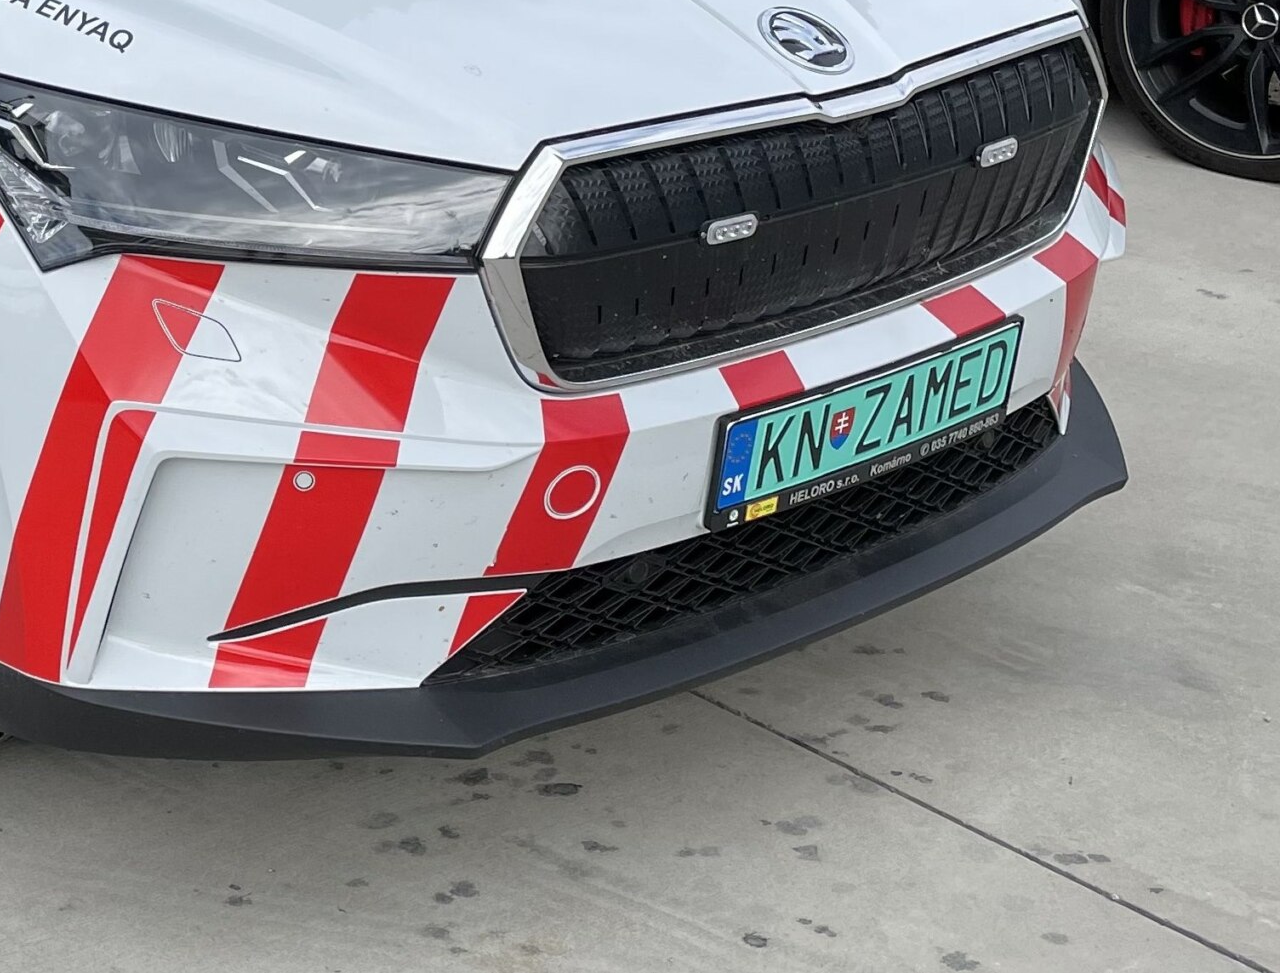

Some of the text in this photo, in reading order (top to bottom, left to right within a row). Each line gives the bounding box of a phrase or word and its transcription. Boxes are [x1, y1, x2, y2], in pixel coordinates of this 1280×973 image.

[756, 339, 1008, 490] KN ZAMED
[722, 473, 744, 496] SK
[788, 480, 834, 506] HELORO
[869, 452, 912, 477] Komárno
